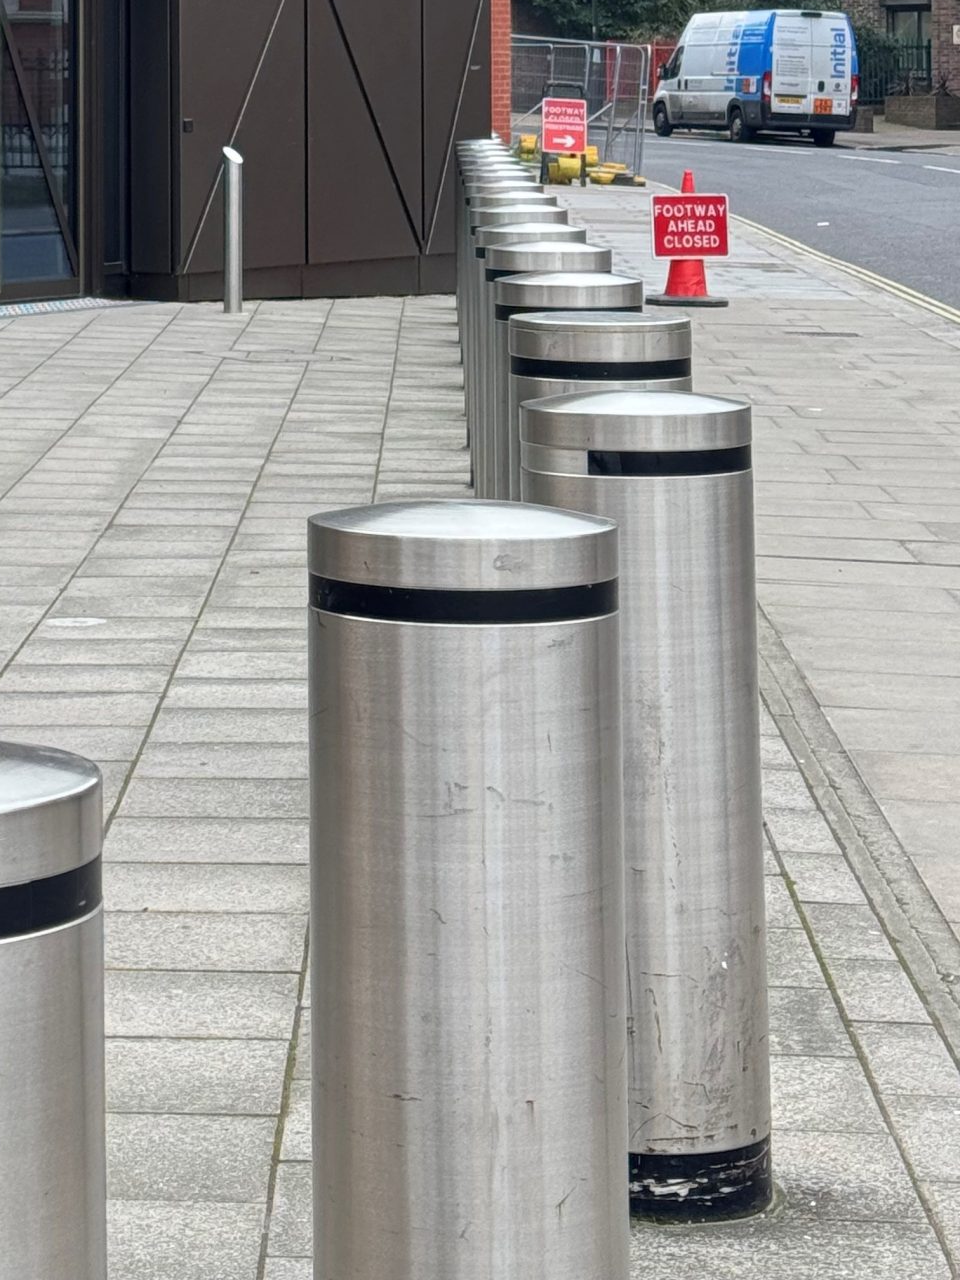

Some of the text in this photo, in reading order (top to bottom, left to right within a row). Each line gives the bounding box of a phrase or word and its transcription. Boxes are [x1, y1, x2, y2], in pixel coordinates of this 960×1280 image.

[830, 27, 846, 79] Initial
[544, 106, 584, 116] FOOTWAY
[654, 204, 725, 218] FOOTWAY
[667, 220, 715, 232] AHEAD
[663, 235, 720, 248] CLOSED
